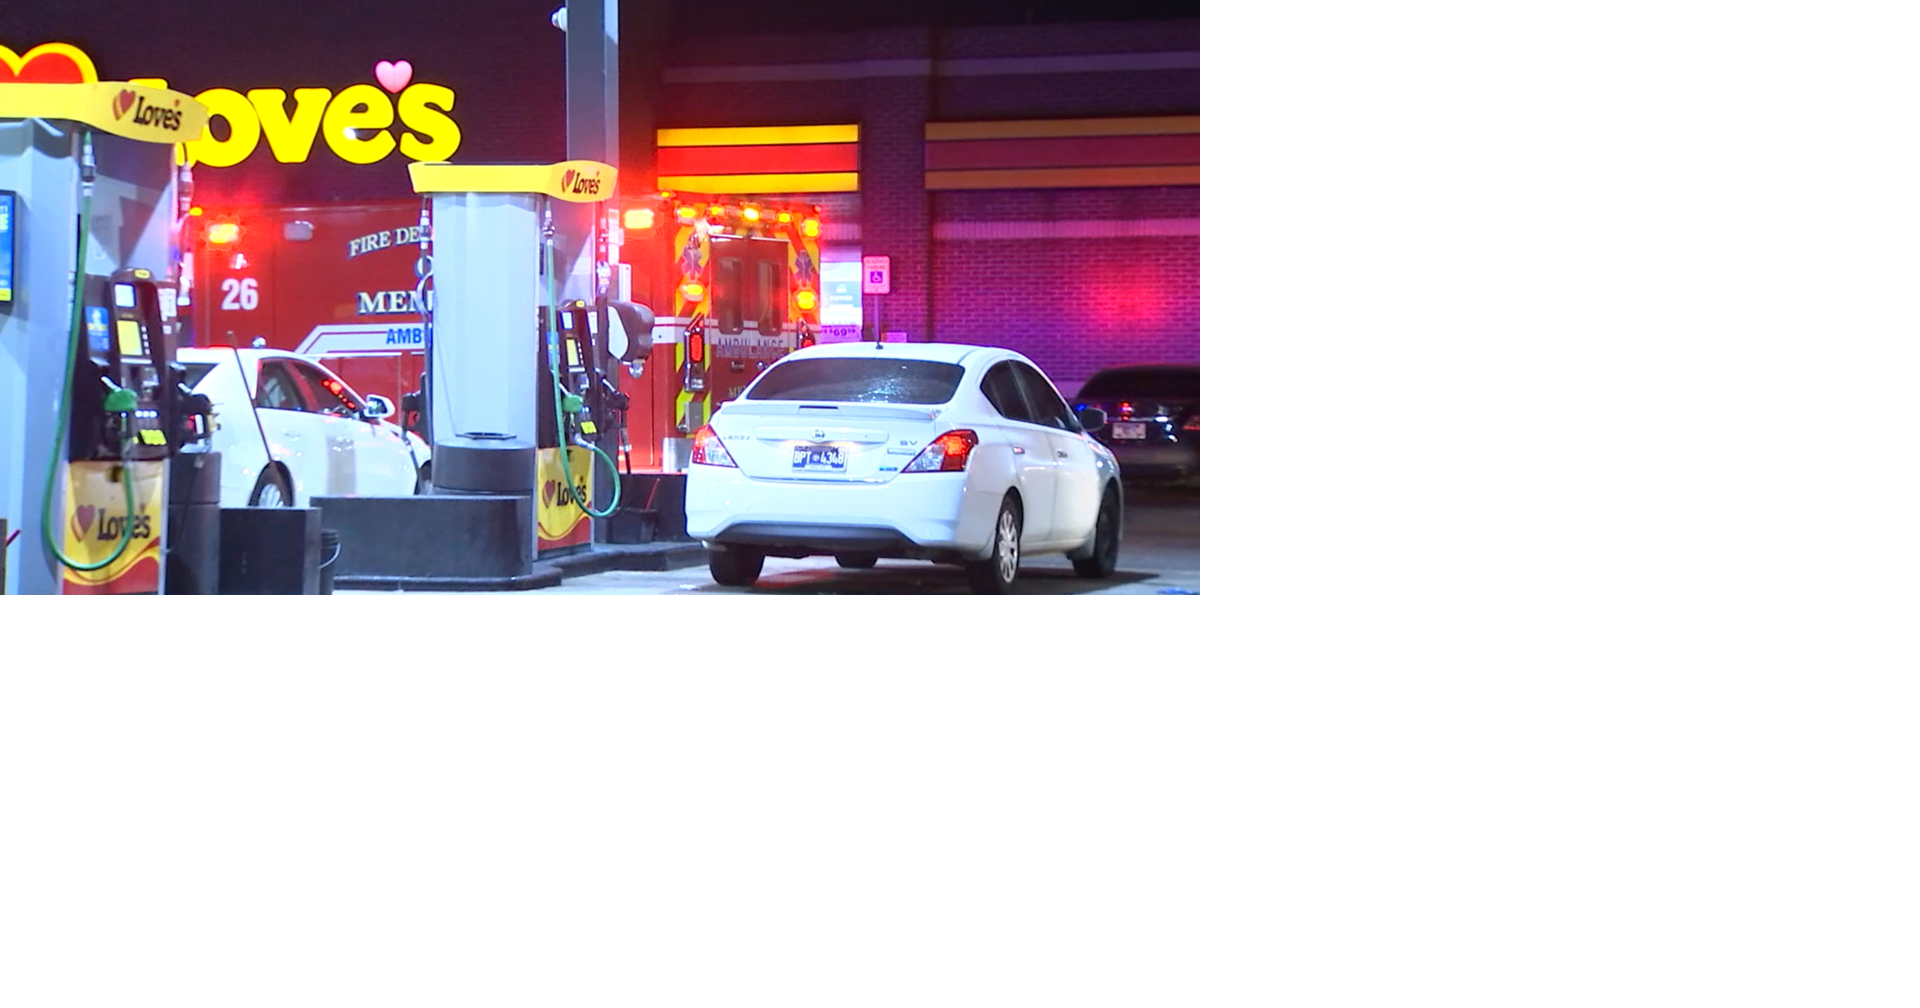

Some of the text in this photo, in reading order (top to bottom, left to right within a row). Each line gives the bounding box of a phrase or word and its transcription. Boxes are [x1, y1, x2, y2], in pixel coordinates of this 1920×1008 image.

[128, 59, 463, 168] ove's
[348, 225, 421, 258] FIRE DE
[221, 278, 259, 310] 26
[386, 328, 424, 344] AMB
[716, 338, 785, 359] AMBULANCE
[793, 450, 845, 465] BPT 4348
